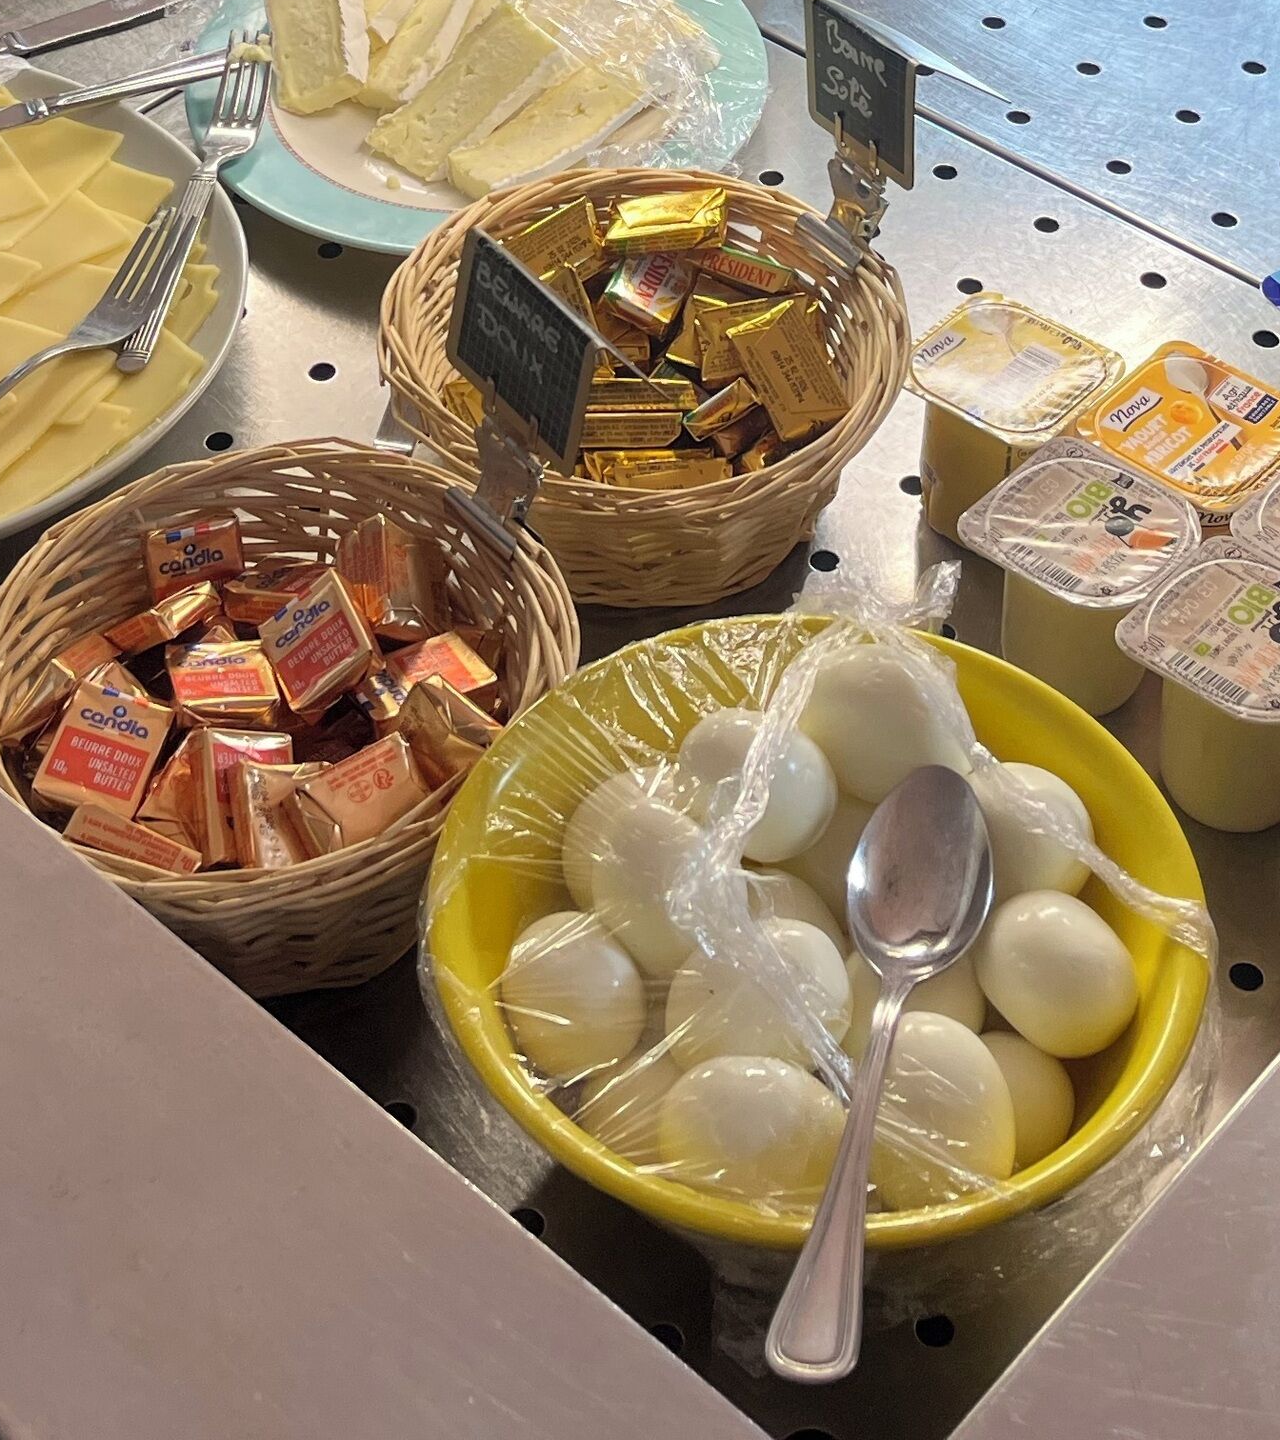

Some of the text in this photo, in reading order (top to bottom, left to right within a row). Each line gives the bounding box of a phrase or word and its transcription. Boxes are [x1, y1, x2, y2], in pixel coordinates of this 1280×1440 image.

[916, 335, 955, 364] Nova
[1110, 393, 1152, 426] Nova
[1066, 478, 1115, 519] BIO
[1197, 511, 1233, 524] Nov
[159, 545, 224, 575] candia
[1227, 583, 1278, 626] BIO
[275, 599, 331, 649] candia
[288, 618, 345, 669] BEURRE DOUX
[310, 628, 350, 665] UNSALTED
[80, 707, 150, 739] candia
[70, 735, 143, 768] BEURRE DOUX
[87, 757, 138, 782] UNSALTED
[92, 771, 133, 794] BUTTER
